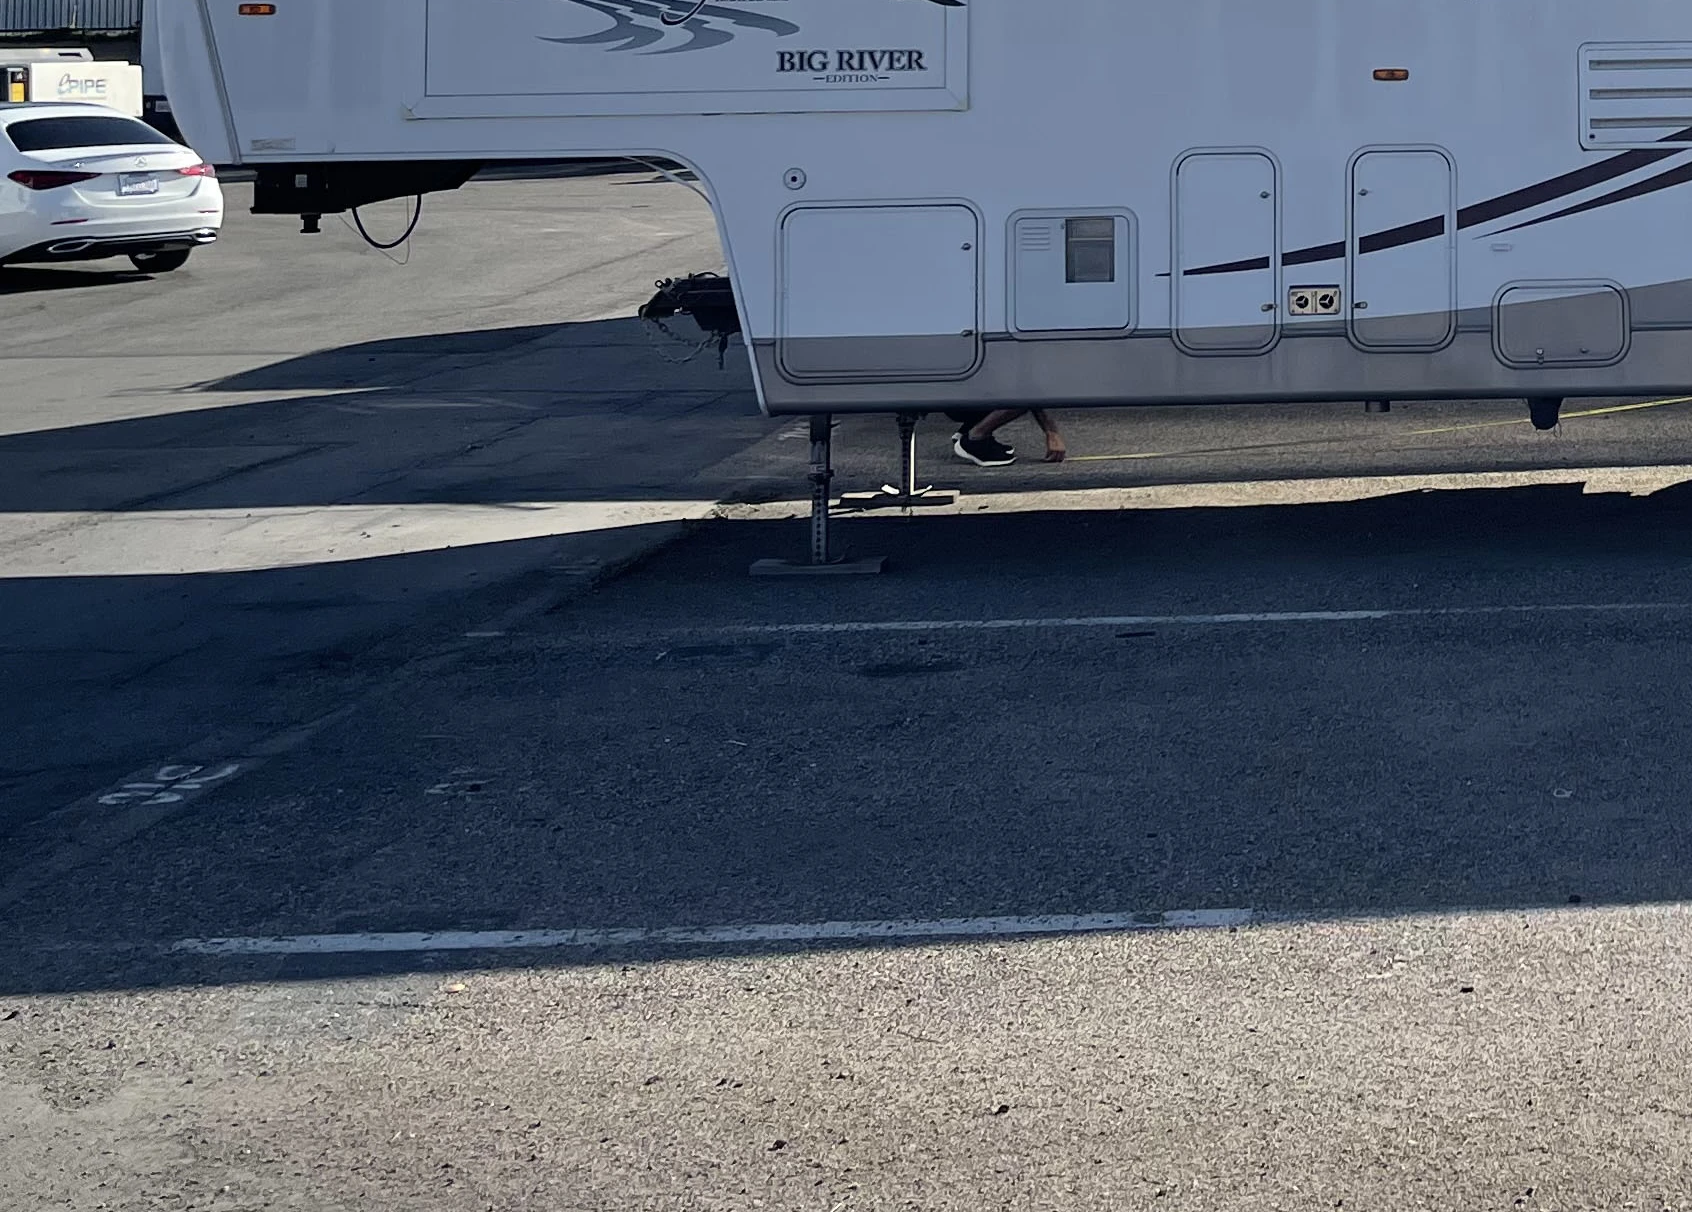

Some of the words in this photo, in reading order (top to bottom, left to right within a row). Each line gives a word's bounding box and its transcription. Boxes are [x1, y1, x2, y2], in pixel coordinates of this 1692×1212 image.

[775, 50, 830, 73] BIG
[836, 49, 927, 72] RIVER
[825, 74, 879, 84] EDITION
